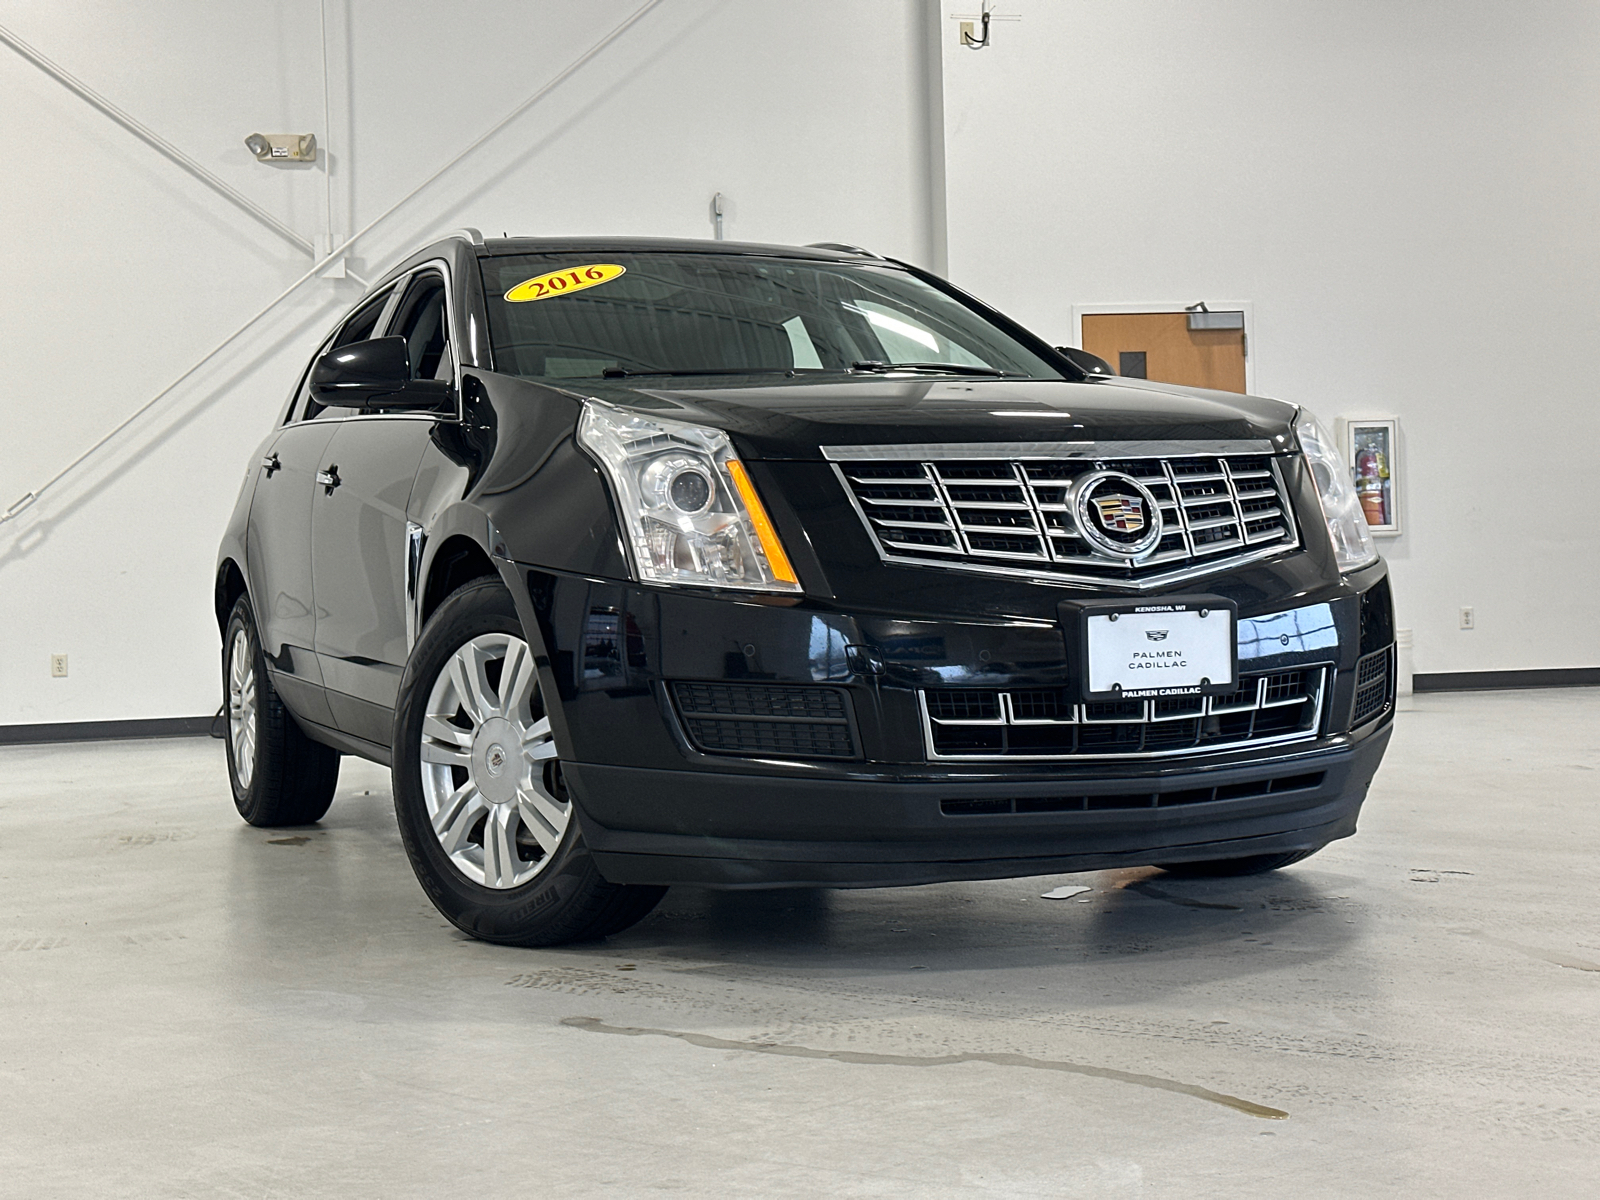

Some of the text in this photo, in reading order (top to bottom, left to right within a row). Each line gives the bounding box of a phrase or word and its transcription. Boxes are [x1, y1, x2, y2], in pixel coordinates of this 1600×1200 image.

[529, 266, 604, 297] 2016
[1133, 651, 1182, 659] PALMEN
[1128, 660, 1187, 669] CADILLAC
[1122, 687, 1201, 698] PALMEN CADILLAC
